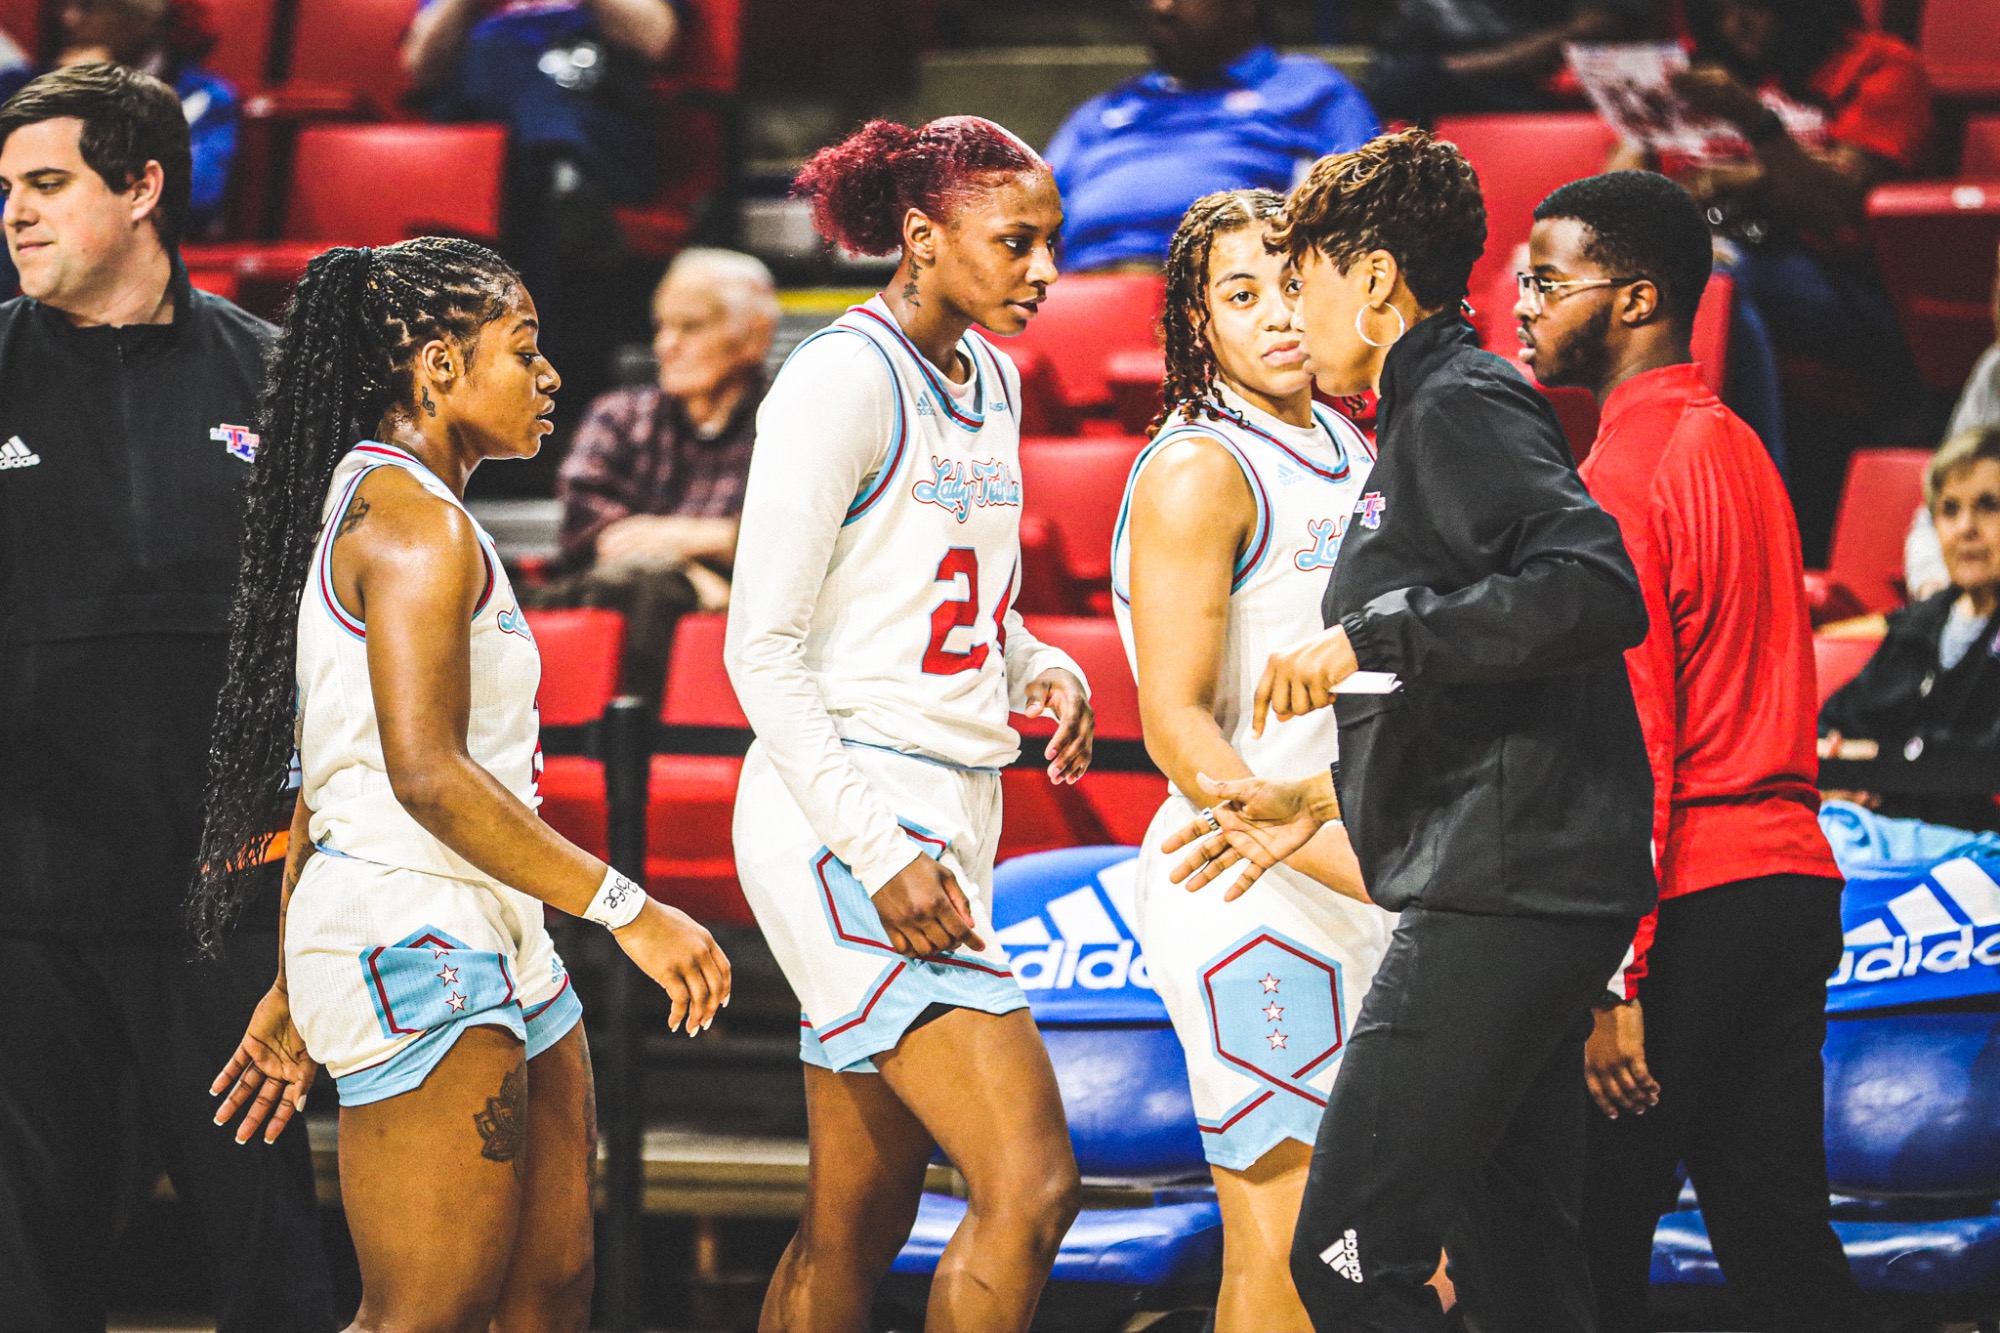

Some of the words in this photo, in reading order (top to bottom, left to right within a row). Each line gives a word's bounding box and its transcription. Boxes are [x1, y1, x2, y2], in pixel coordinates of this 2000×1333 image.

[0, 453, 41, 470] didas
[912, 455, 972, 525] Lady
[1343, 1228, 1364, 1284] adidas
